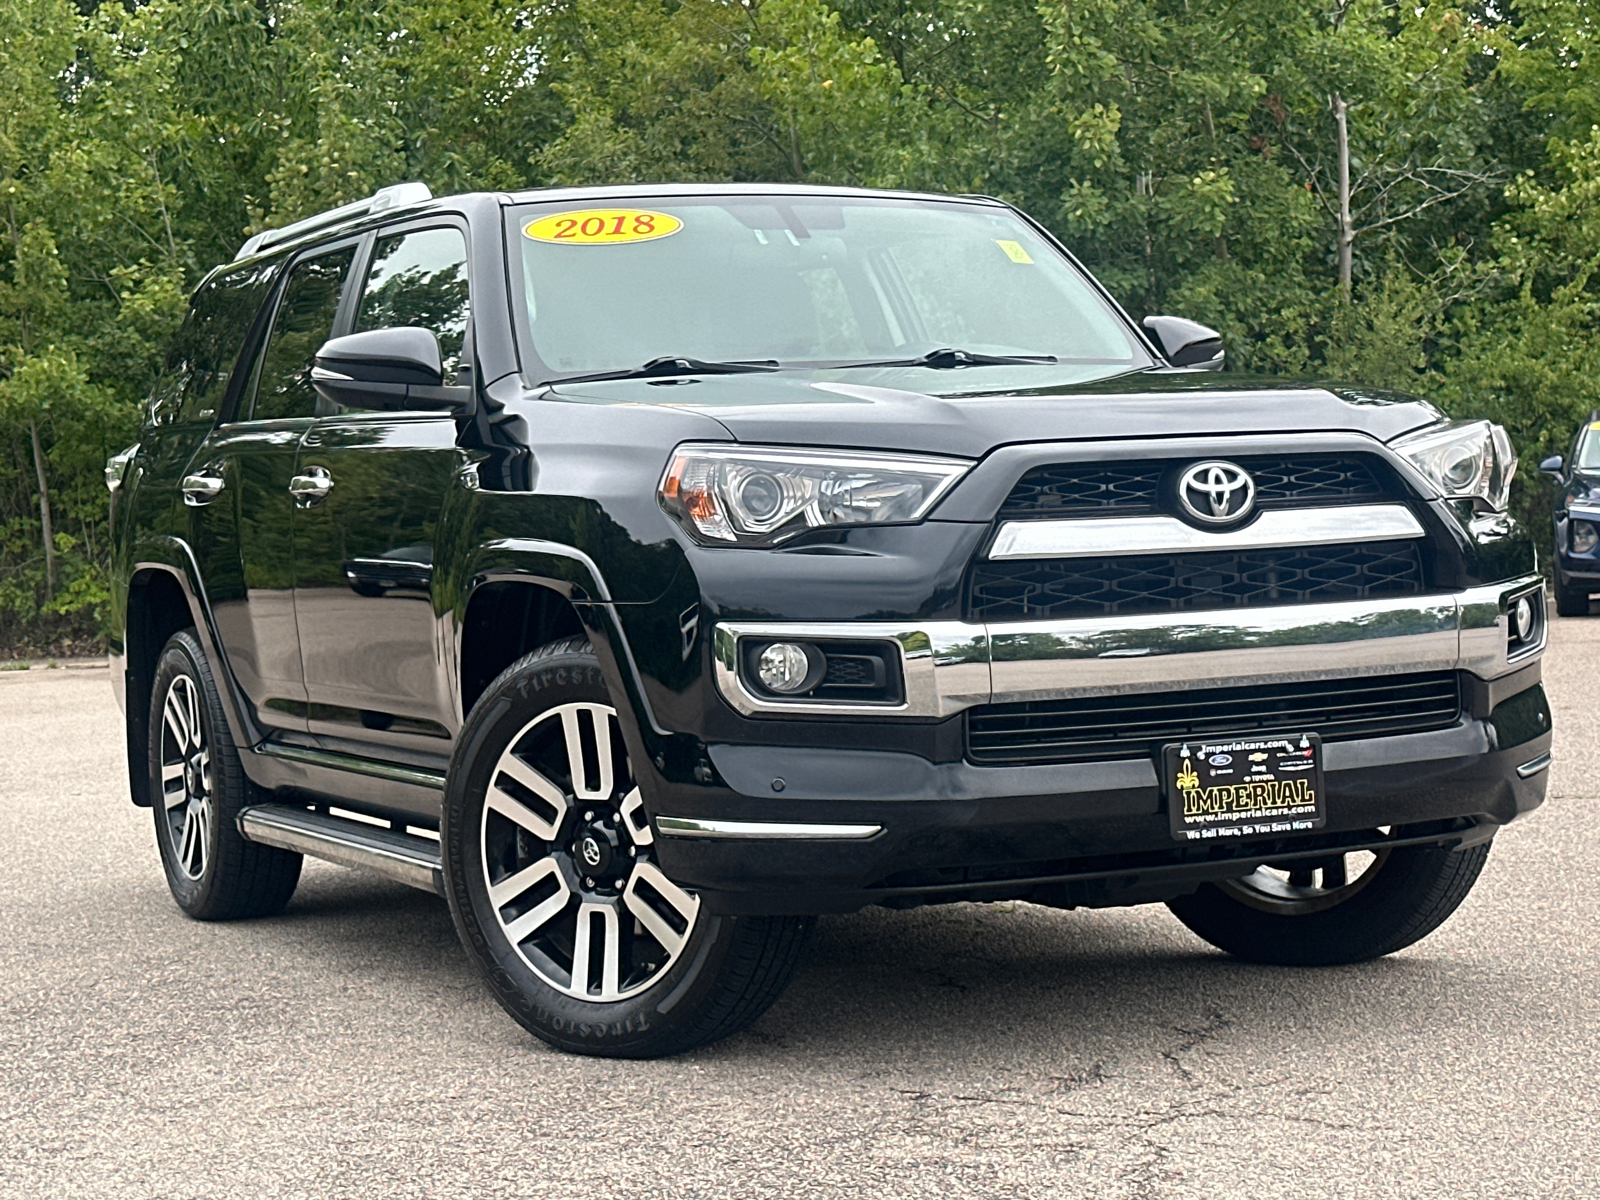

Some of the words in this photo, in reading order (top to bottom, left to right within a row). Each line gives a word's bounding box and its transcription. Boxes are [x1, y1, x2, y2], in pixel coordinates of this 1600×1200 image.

[553, 214, 656, 239] 2018
[1183, 779, 1315, 815] IMPERIAL
[1184, 805, 1316, 824] www.imperialcars.com
[1186, 831, 1201, 840] We
[1201, 828, 1217, 838] Sell
[1242, 825, 1254, 834] So
[1254, 823, 1271, 833] You
[1271, 821, 1292, 832] Save
[1292, 820, 1313, 830] More
